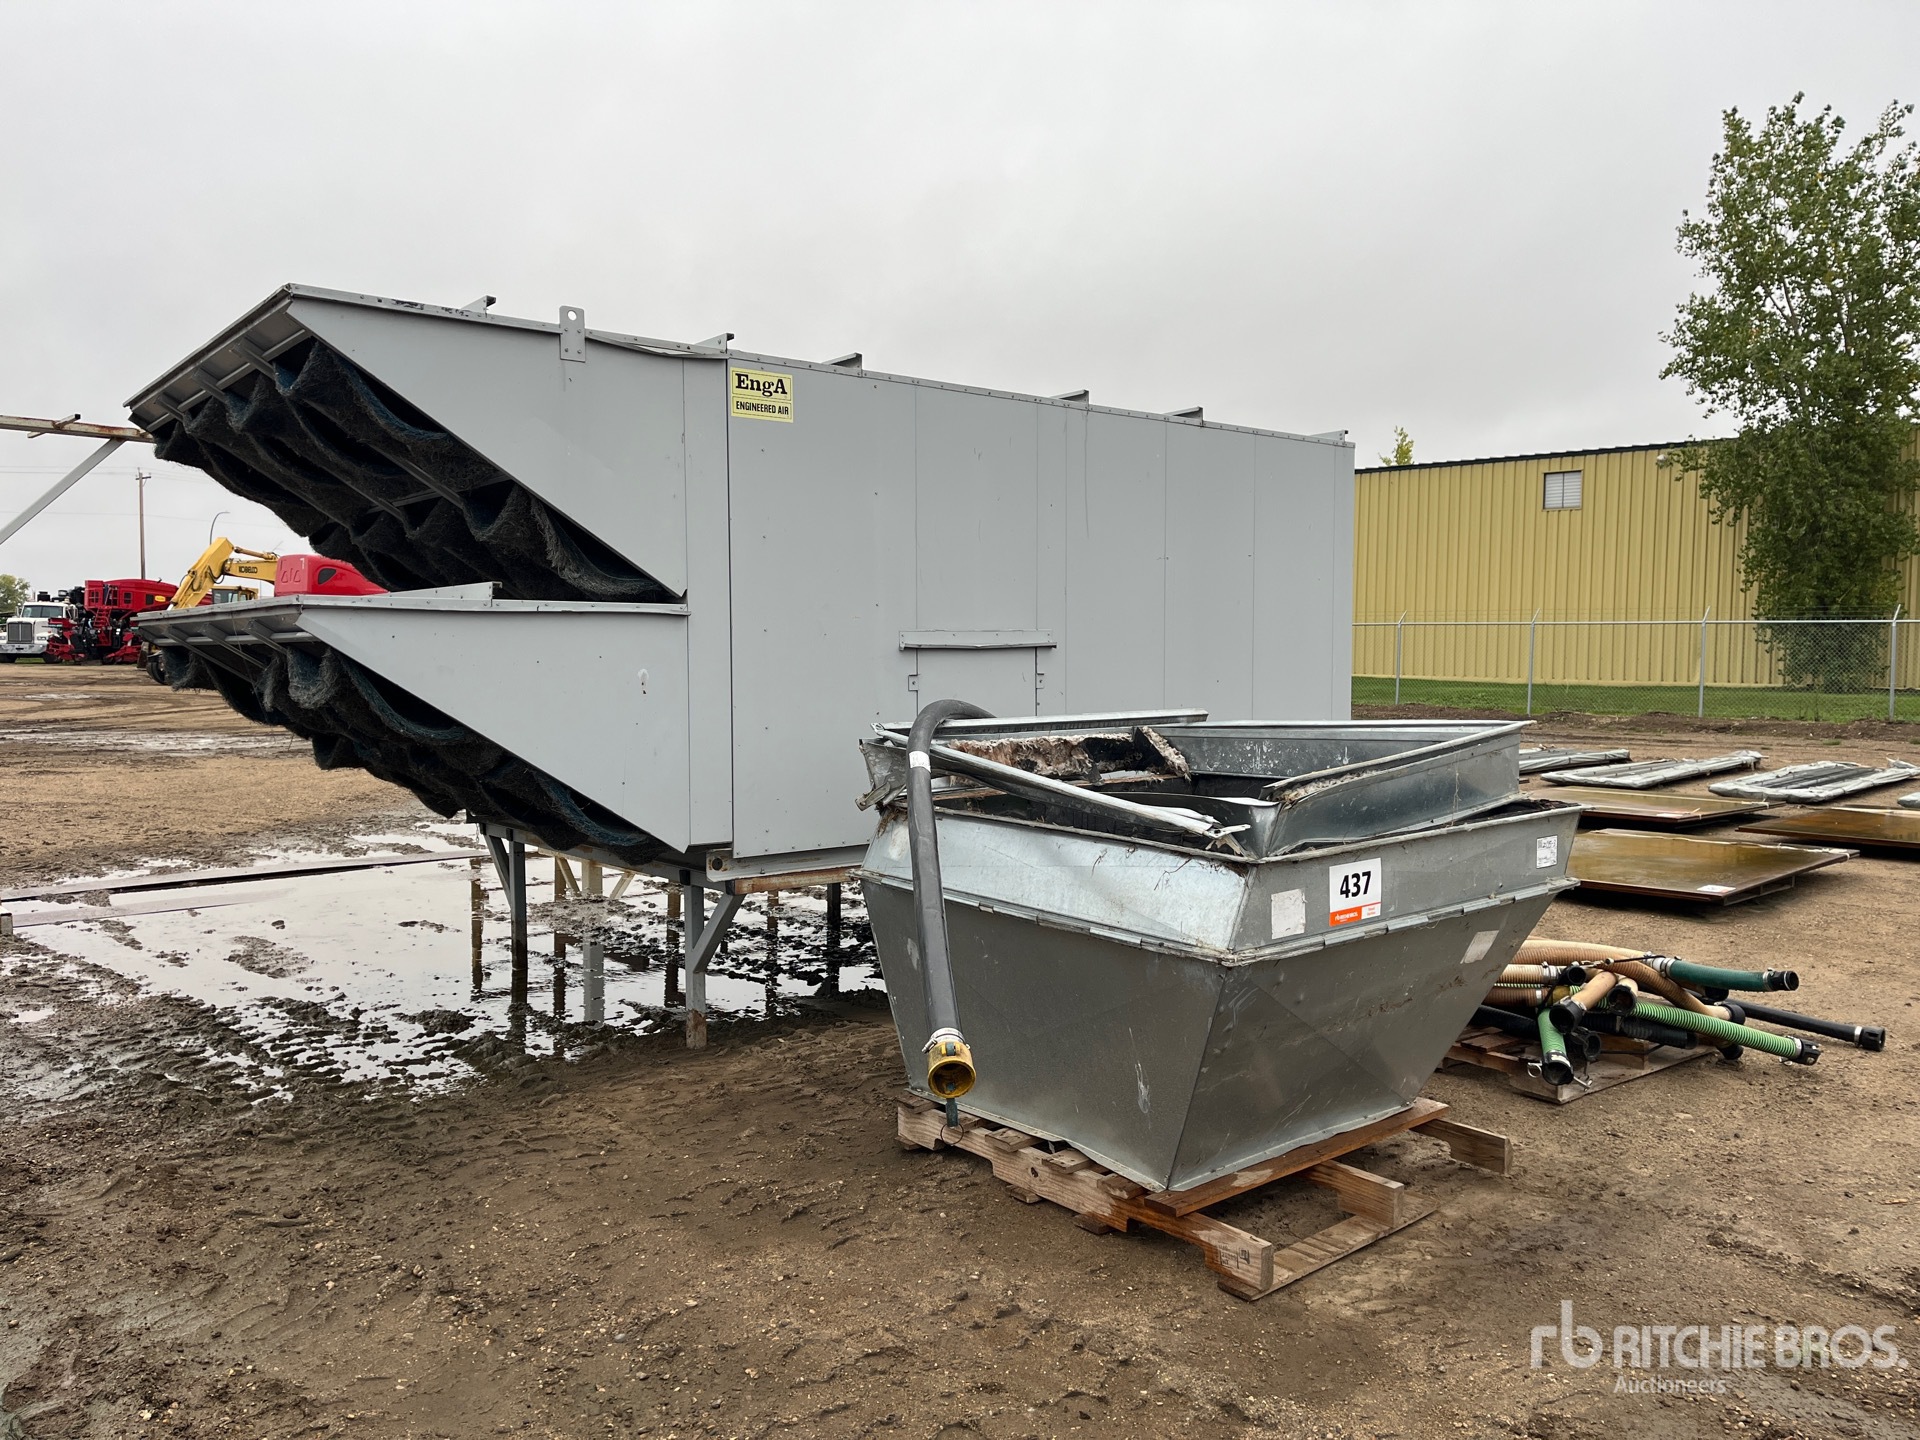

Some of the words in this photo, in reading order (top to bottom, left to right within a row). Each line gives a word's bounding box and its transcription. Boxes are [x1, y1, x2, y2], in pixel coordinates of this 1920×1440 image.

[735, 373, 788, 397] EngA
[736, 401, 777, 414] ENGINEERED
[778, 406, 789, 415] AIR
[1340, 870, 1372, 899] 437
